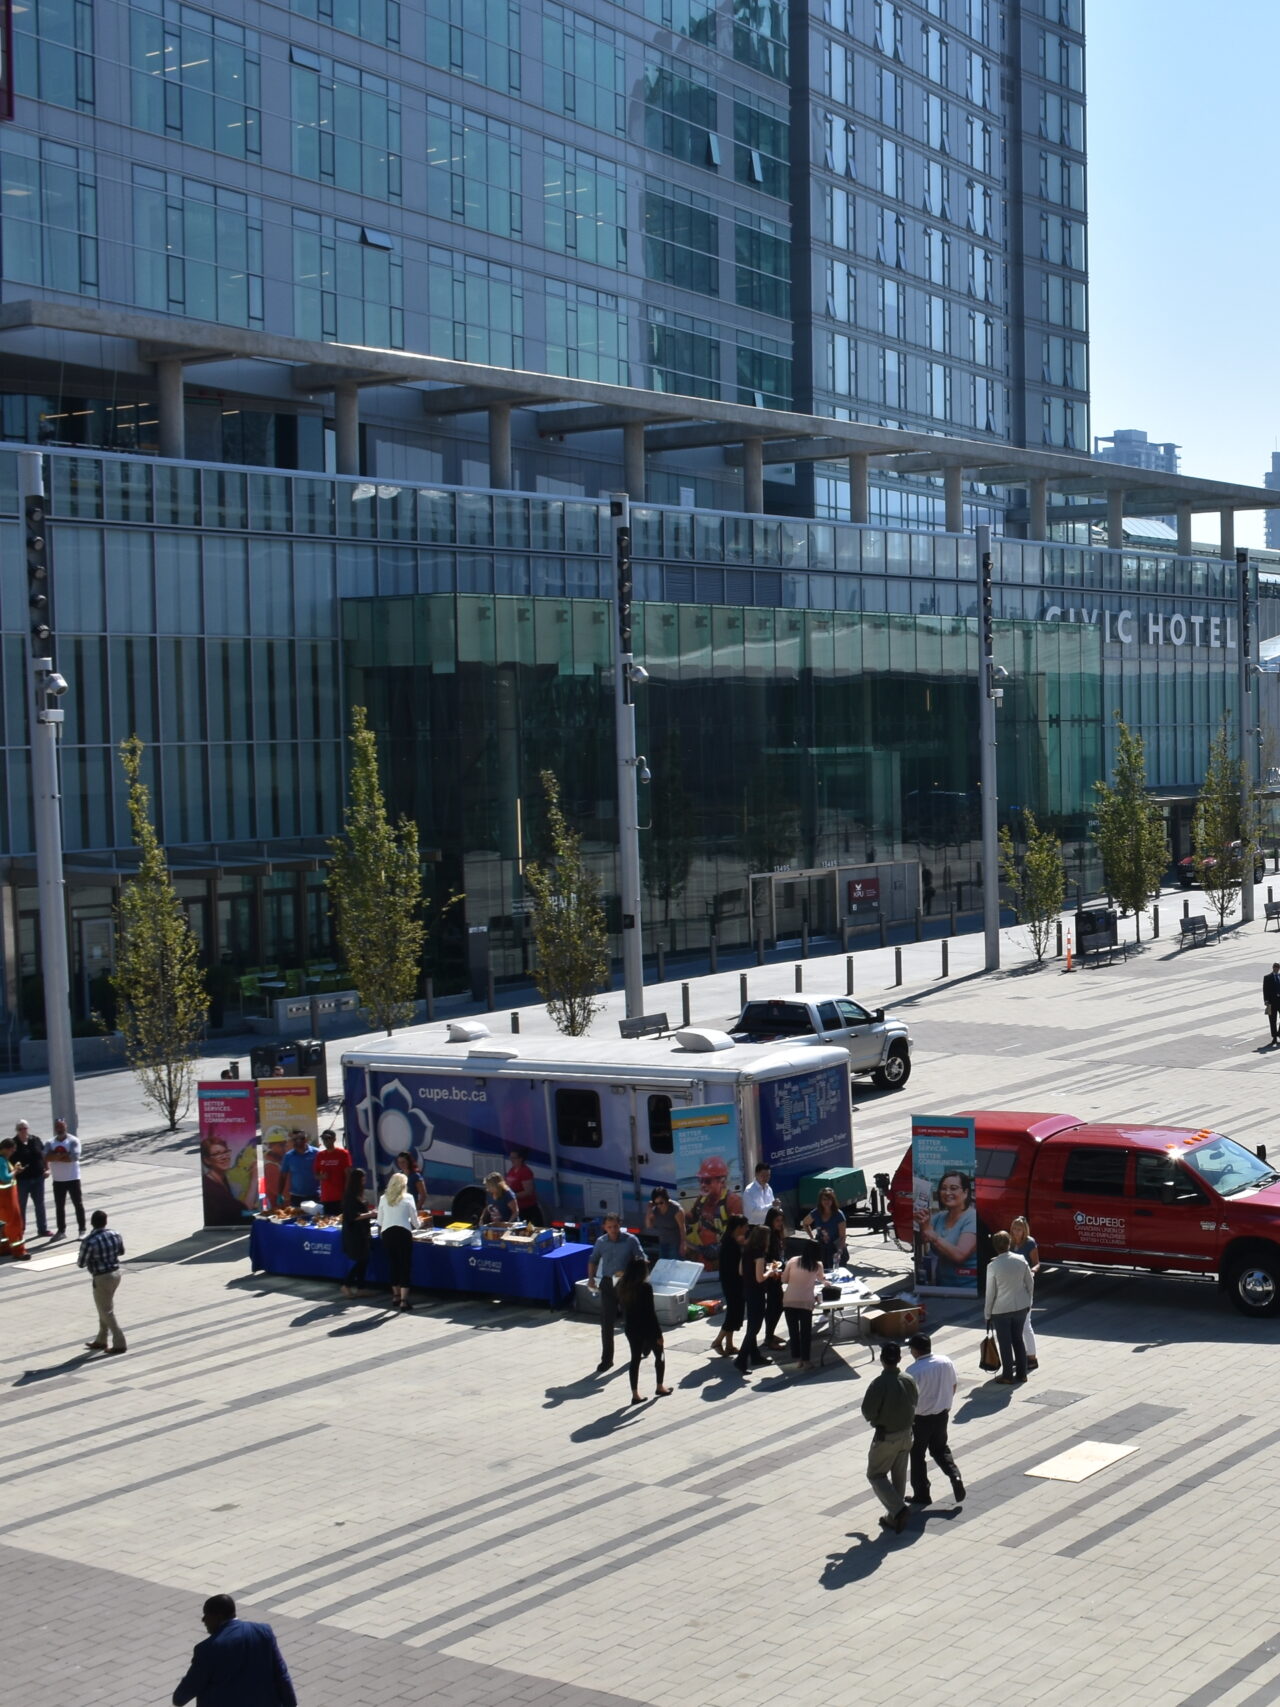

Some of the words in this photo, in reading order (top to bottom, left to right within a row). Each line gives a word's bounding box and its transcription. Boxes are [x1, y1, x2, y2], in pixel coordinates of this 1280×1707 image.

[1149, 612, 1236, 648] HOTEL
[418, 1086, 487, 1102] cupe.bc.ca
[770, 1149, 786, 1160] CUPE
[1086, 1215, 1126, 1228] CUPEBC
